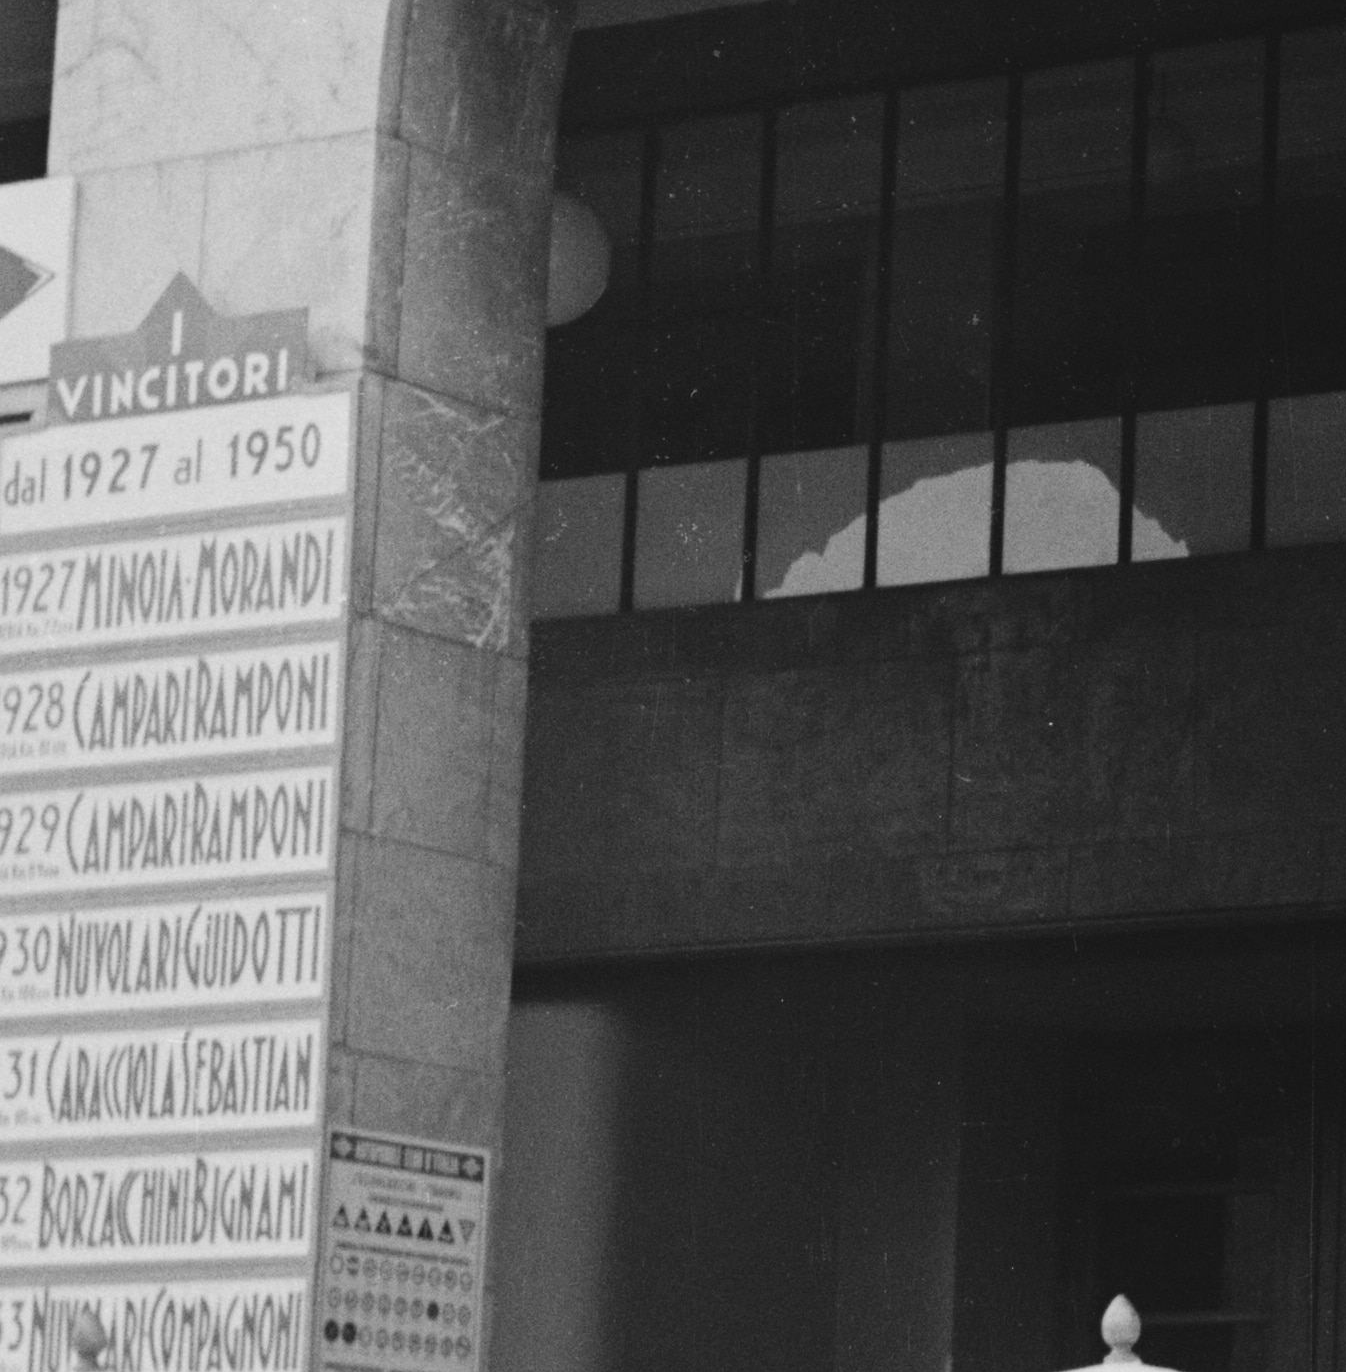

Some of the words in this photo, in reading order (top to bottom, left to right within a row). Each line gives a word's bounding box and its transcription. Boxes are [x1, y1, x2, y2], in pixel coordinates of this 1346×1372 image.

[57, 348, 288, 418] VINCITORI
[4, 458, 47, 507] dal
[63, 444, 160, 501] 1927
[174, 437, 202, 486] al
[227, 422, 322, 480] 1950
[2, 559, 76, 616] 1927
[0, 681, 65, 735] 928
[0, 803, 60, 857] 929
